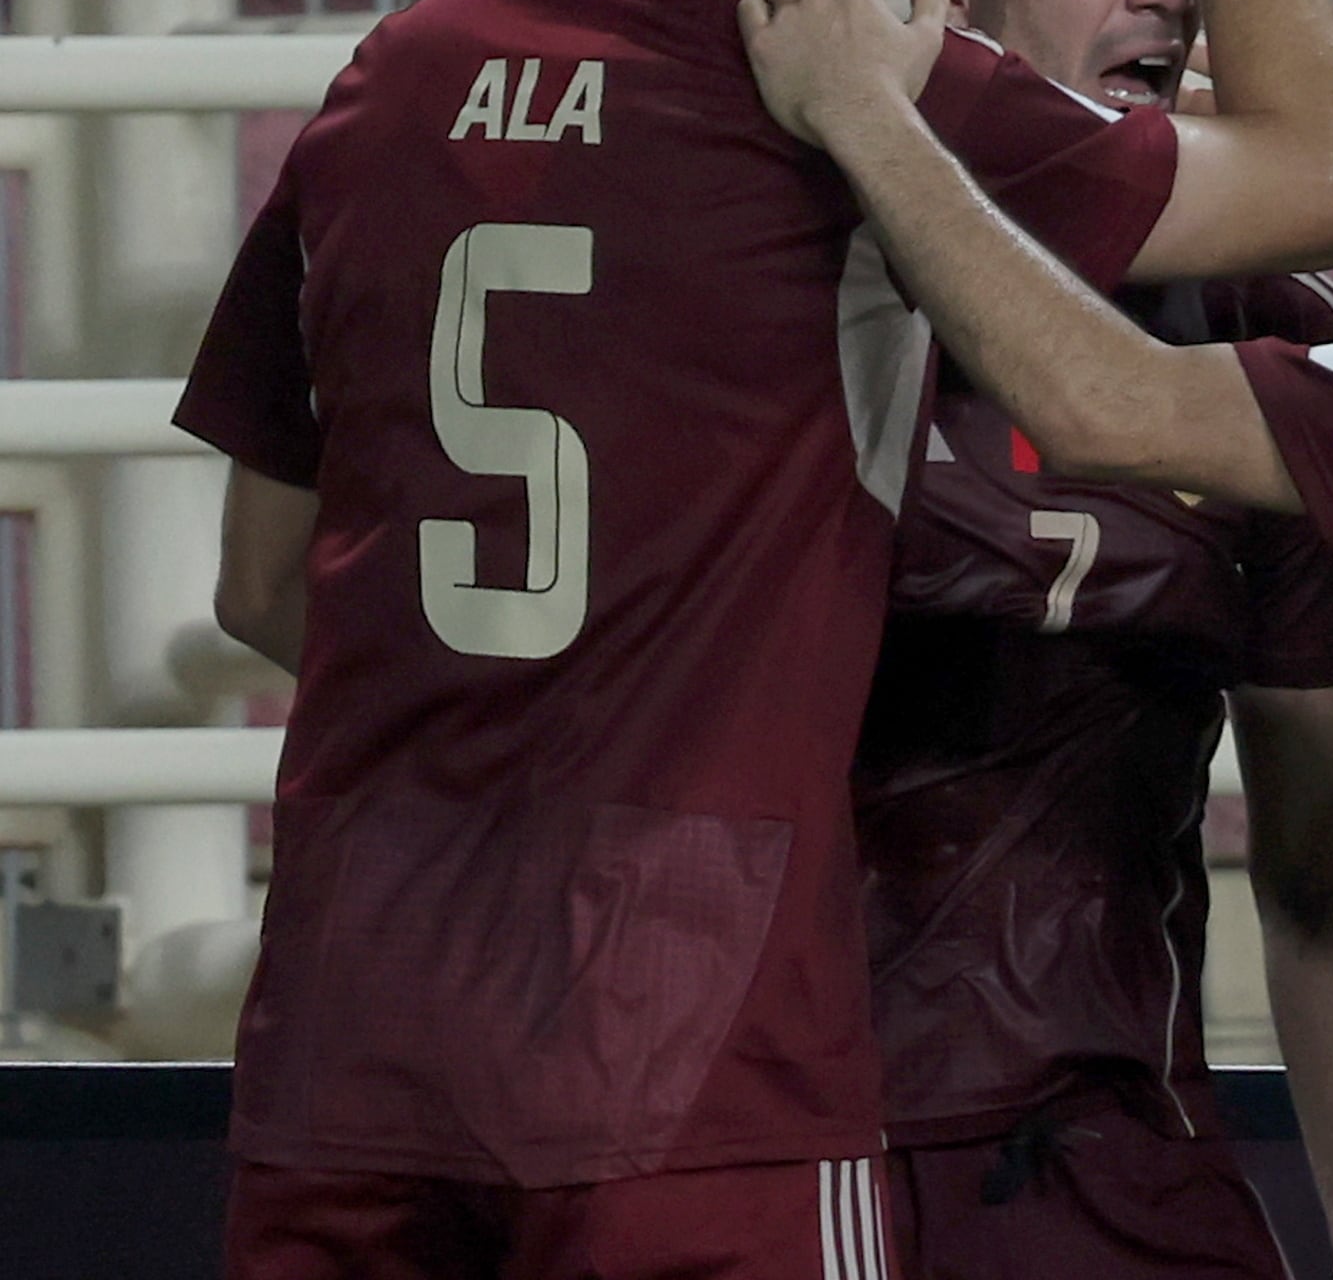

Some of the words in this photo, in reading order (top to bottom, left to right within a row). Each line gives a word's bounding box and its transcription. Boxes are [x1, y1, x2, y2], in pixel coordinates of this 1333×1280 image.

[448, 58, 604, 144] ALA
[419, 223, 593, 658] 5
[1030, 510, 1099, 633] 7
